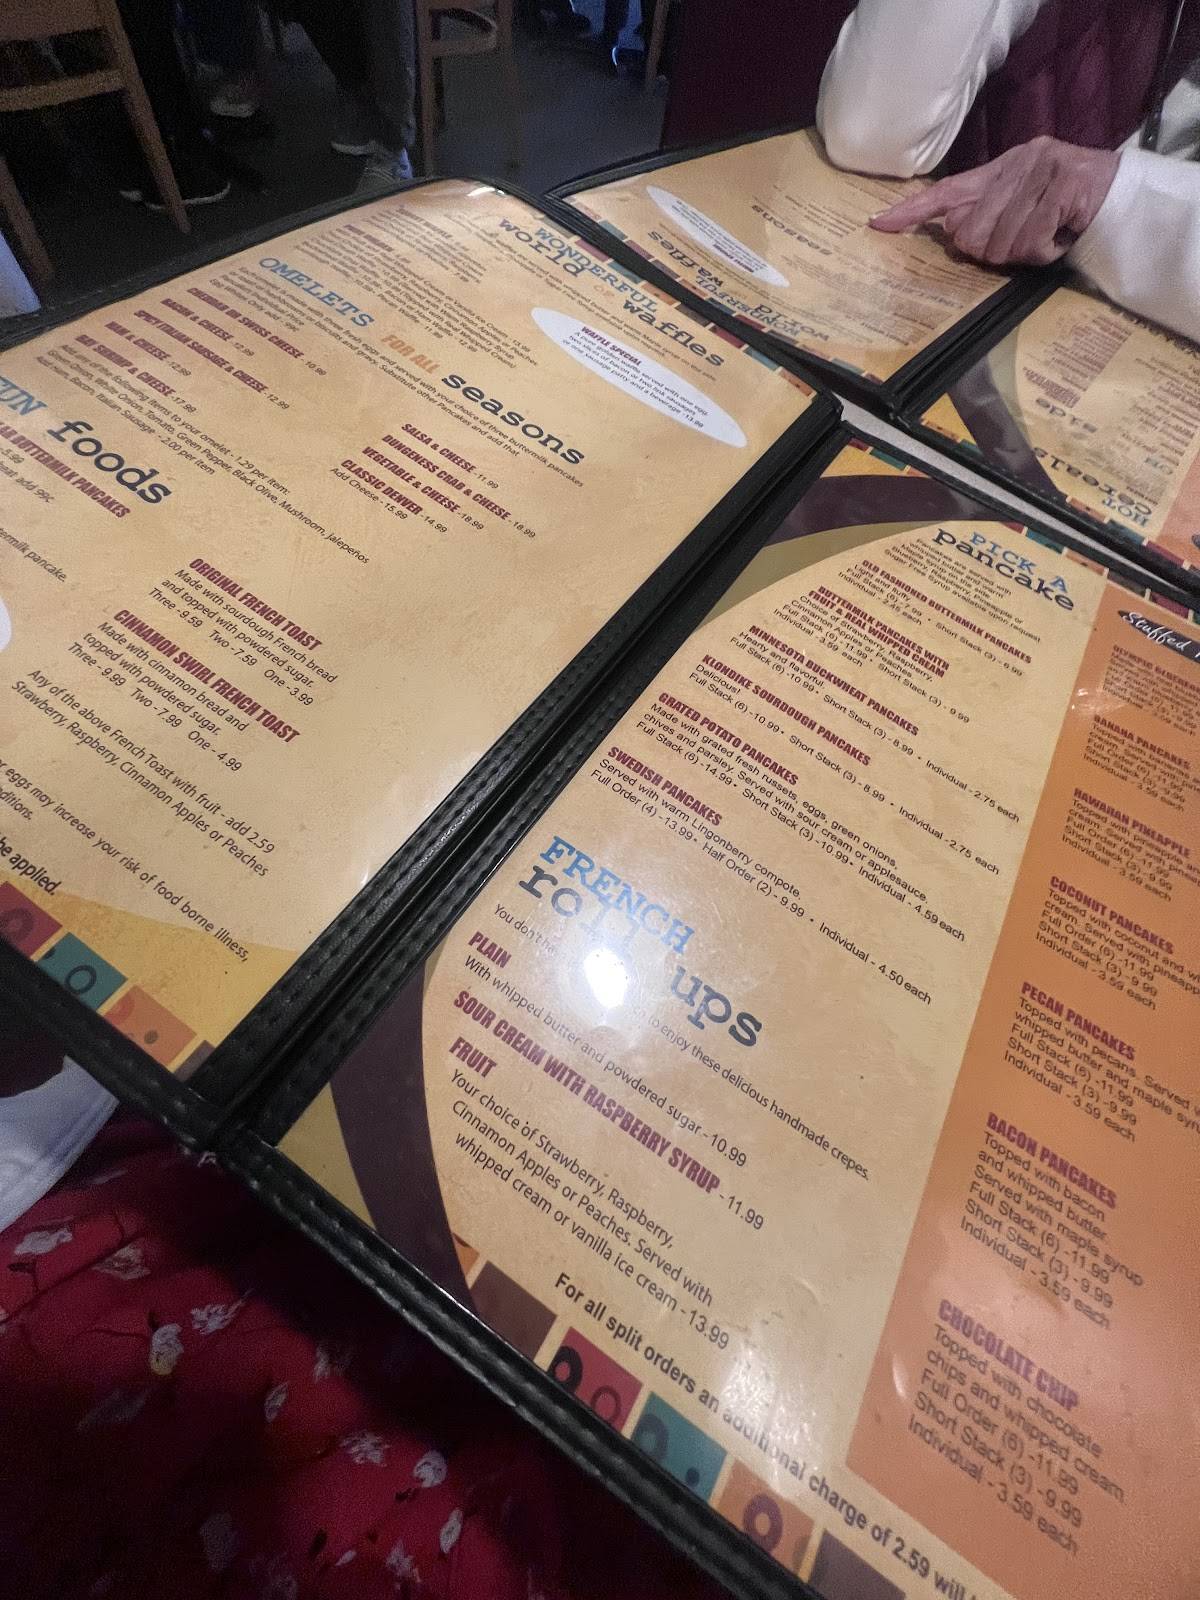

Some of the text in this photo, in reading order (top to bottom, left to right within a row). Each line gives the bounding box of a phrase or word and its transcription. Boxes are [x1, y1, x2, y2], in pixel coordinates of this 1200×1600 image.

[498, 218, 587, 277] world
[534, 227, 658, 313] WONDERFUL
[258, 257, 584, 464] OMELETS FOR ALL seasons
[580, 326, 642, 366] WAFFLE SPECIAL
[622, 299, 724, 367] waffles
[9, 435, 130, 518] BUTTERMILK PANCAKES
[46, 420, 172, 504] foods
[176, 432, 202, 451] Green
[200, 448, 233, 472] Pepper,
[231, 469, 256, 487] Black
[254, 484, 277, 504] Olive,
[278, 500, 325, 536] Mushroom,
[340, 459, 423, 515] CLASSIC DENVER
[380, 434, 511, 520] DUNGENESS CRAB & CHEESE
[400, 423, 432, 445] SALSA
[429, 443, 439, 451] &
[438, 447, 476, 473] CHEESE
[188, 558, 322, 650] ORIGINAL FRENCH TOAST
[931, 528, 1074, 611] pancake
[968, 531, 1068, 593] PICK A
[160, 579, 314, 688] and topped with powdered sugar.
[817, 585, 949, 670] BUTTERMILK PANCAKES WITH
[861, 559, 1031, 663] OLD FASHIONED BUTTERMILK PANCAKES
[1123, 611, 1191, 652] Stuffed
[96, 621, 250, 731] Made with cinnamon bread and
[113, 609, 300, 742] CINNAMON SWIRL FRENCH TOAST
[695, 663, 741, 695] Delicious!
[701, 654, 871, 766] KLONDIKE SOURDOUGH PANCAKES
[748, 624, 919, 736] MINNESOTA BUCKWHEAT PANCAKES
[10, 680, 268, 876] Strawberry, Raspberry, Cinnamon Apples or Peaches
[658, 692, 798, 786] GRATED POTATO PANCAKES
[599, 758, 801, 900] Served with warm Lingonberry compote.
[607, 746, 722, 826] SWEDISH PANCAKES
[650, 702, 898, 870] Made with grated fresh russets, eggs, green onions,
[5, 766, 249, 963] eggs may increase your risk of food borne illness,
[9, 851, 62, 896] applied.
[538, 835, 696, 955] FRENCH
[467, 931, 511, 968] PLAIN
[1050, 875, 1173, 955] COCONUT PANCAKES
[464, 954, 491, 981] With
[491, 977, 544, 1024] whipped
[539, 1011, 582, 1051] butter
[578, 1039, 606, 1064] and
[602, 1060, 667, 1109] powdered
[665, 1105, 702, 1135] sugar
[669, 965, 764, 1048] ups
[1021, 981, 1135, 1061] PECAN PANCAKES
[448, 1036, 497, 1079] FRUIT
[453, 990, 496, 1029] SOUR
[492, 1019, 546, 1066] CREAM
[542, 1054, 586, 1096] WITH
[582, 1084, 671, 1158] RASPBERRY
[667, 1146, 720, 1194] SYRUP
[656, 1022, 869, 1181] enjoy these delicious handmade crepes.
[450, 1068, 673, 1249] Your choice of Strawberry, Raspberry,
[983, 1130, 1105, 1223] Topped with bacon
[986, 1111, 1116, 1209] BACON PANCAKES
[455, 1132, 678, 1312] whipped cream or vanilla ice cream
[937, 1299, 1079, 1412] CHOCOLATE CHIP
[554, 1271, 584, 1304] For
[583, 1298, 607, 1322] all
[605, 1316, 643, 1352] split
[643, 1345, 696, 1394] orders
[697, 1388, 719, 1414] an
[807, 1473, 868, 1531] charge
[870, 1524, 893, 1548] of
[891, 1536, 930, 1579] 2.59
